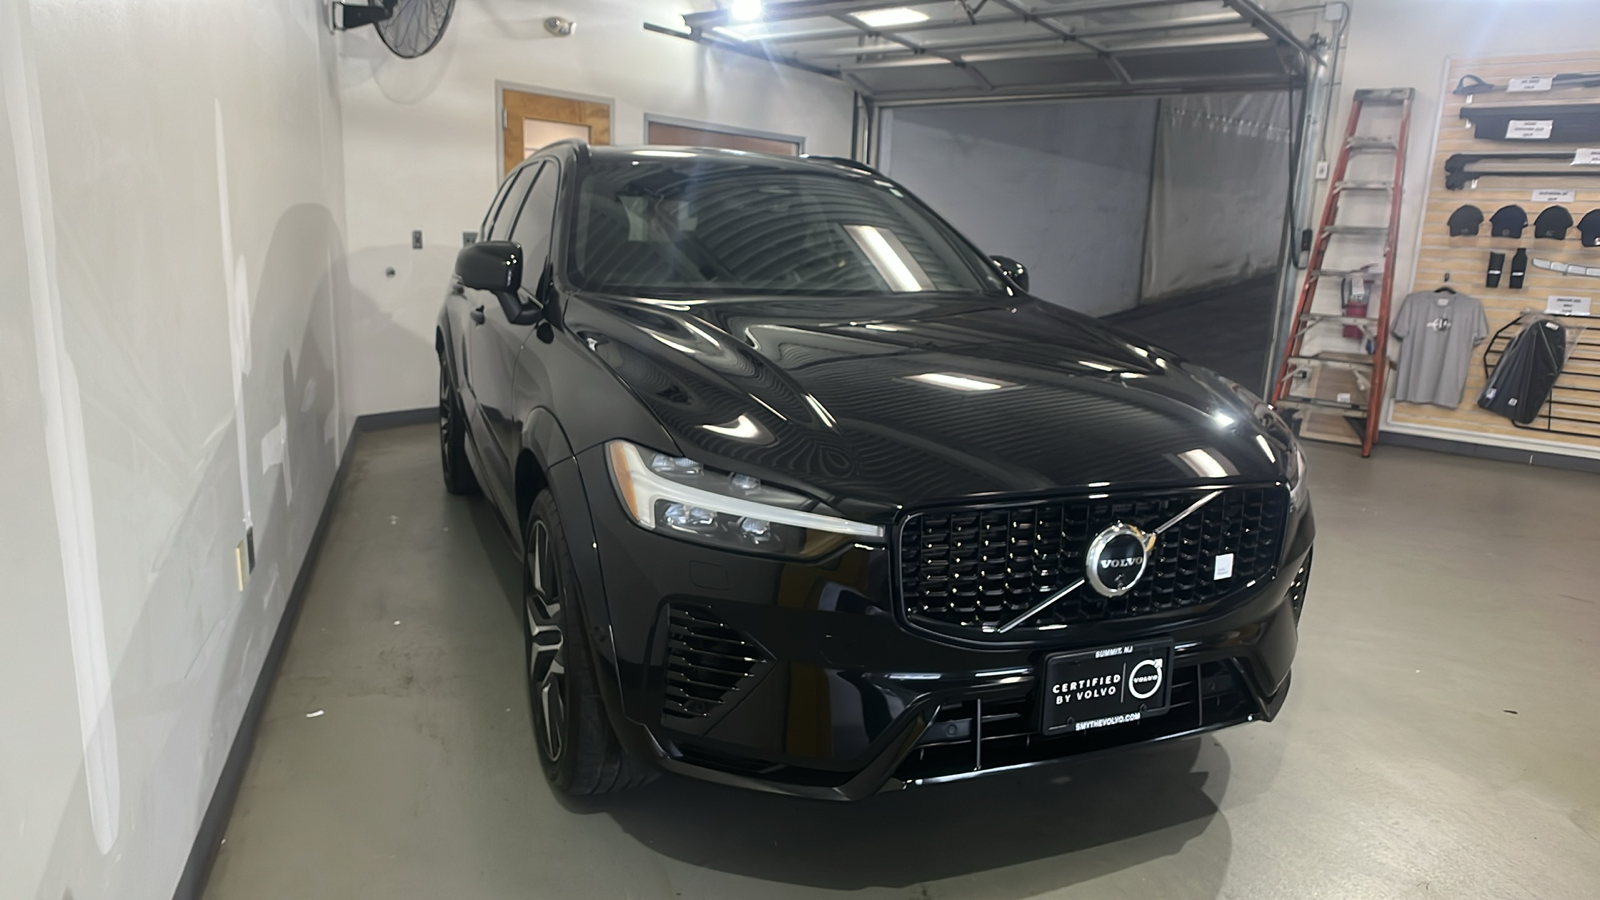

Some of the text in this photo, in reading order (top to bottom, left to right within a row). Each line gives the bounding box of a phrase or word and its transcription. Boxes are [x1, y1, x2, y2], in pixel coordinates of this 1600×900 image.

[1100, 556, 1143, 569] VOLVO
[1123, 645, 1133, 654] NJ
[1052, 674, 1121, 694] CERTIFIED
[1133, 674, 1158, 683] VOLVO
[1056, 686, 1116, 705] BY VOLVO
[1075, 712, 1141, 731] SMYTHEVOLVO.COM
